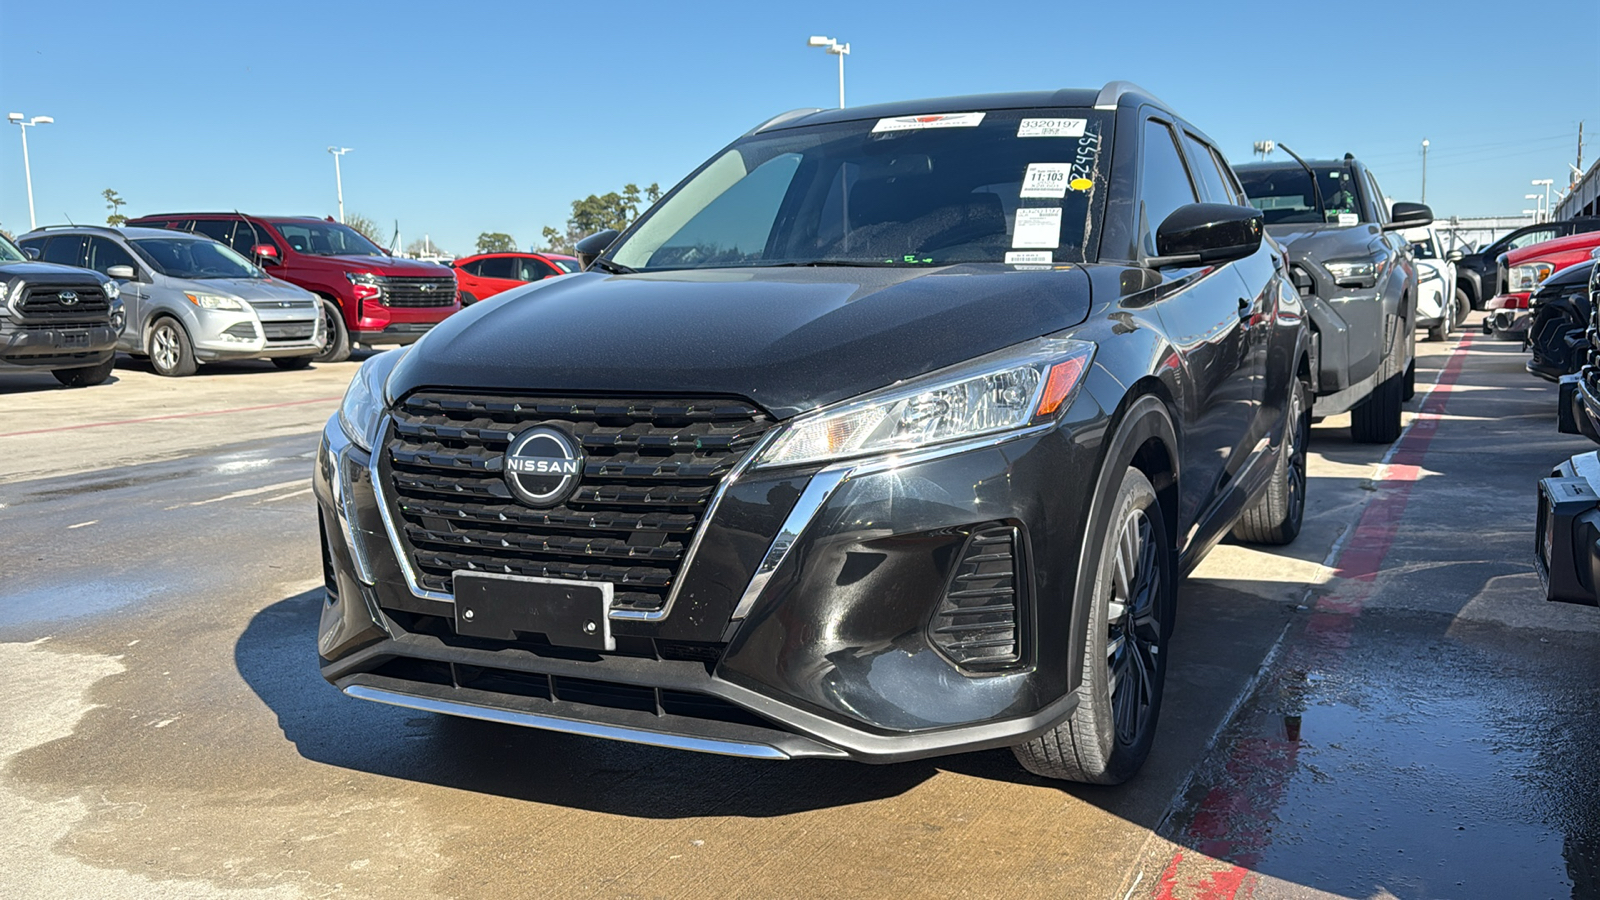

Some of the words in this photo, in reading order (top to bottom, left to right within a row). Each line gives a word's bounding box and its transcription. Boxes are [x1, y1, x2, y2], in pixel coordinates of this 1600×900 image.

[1022, 120, 1080, 128] 3320197
[1031, 173, 1064, 181] 11:103
[507, 458, 577, 473] NISSAN
